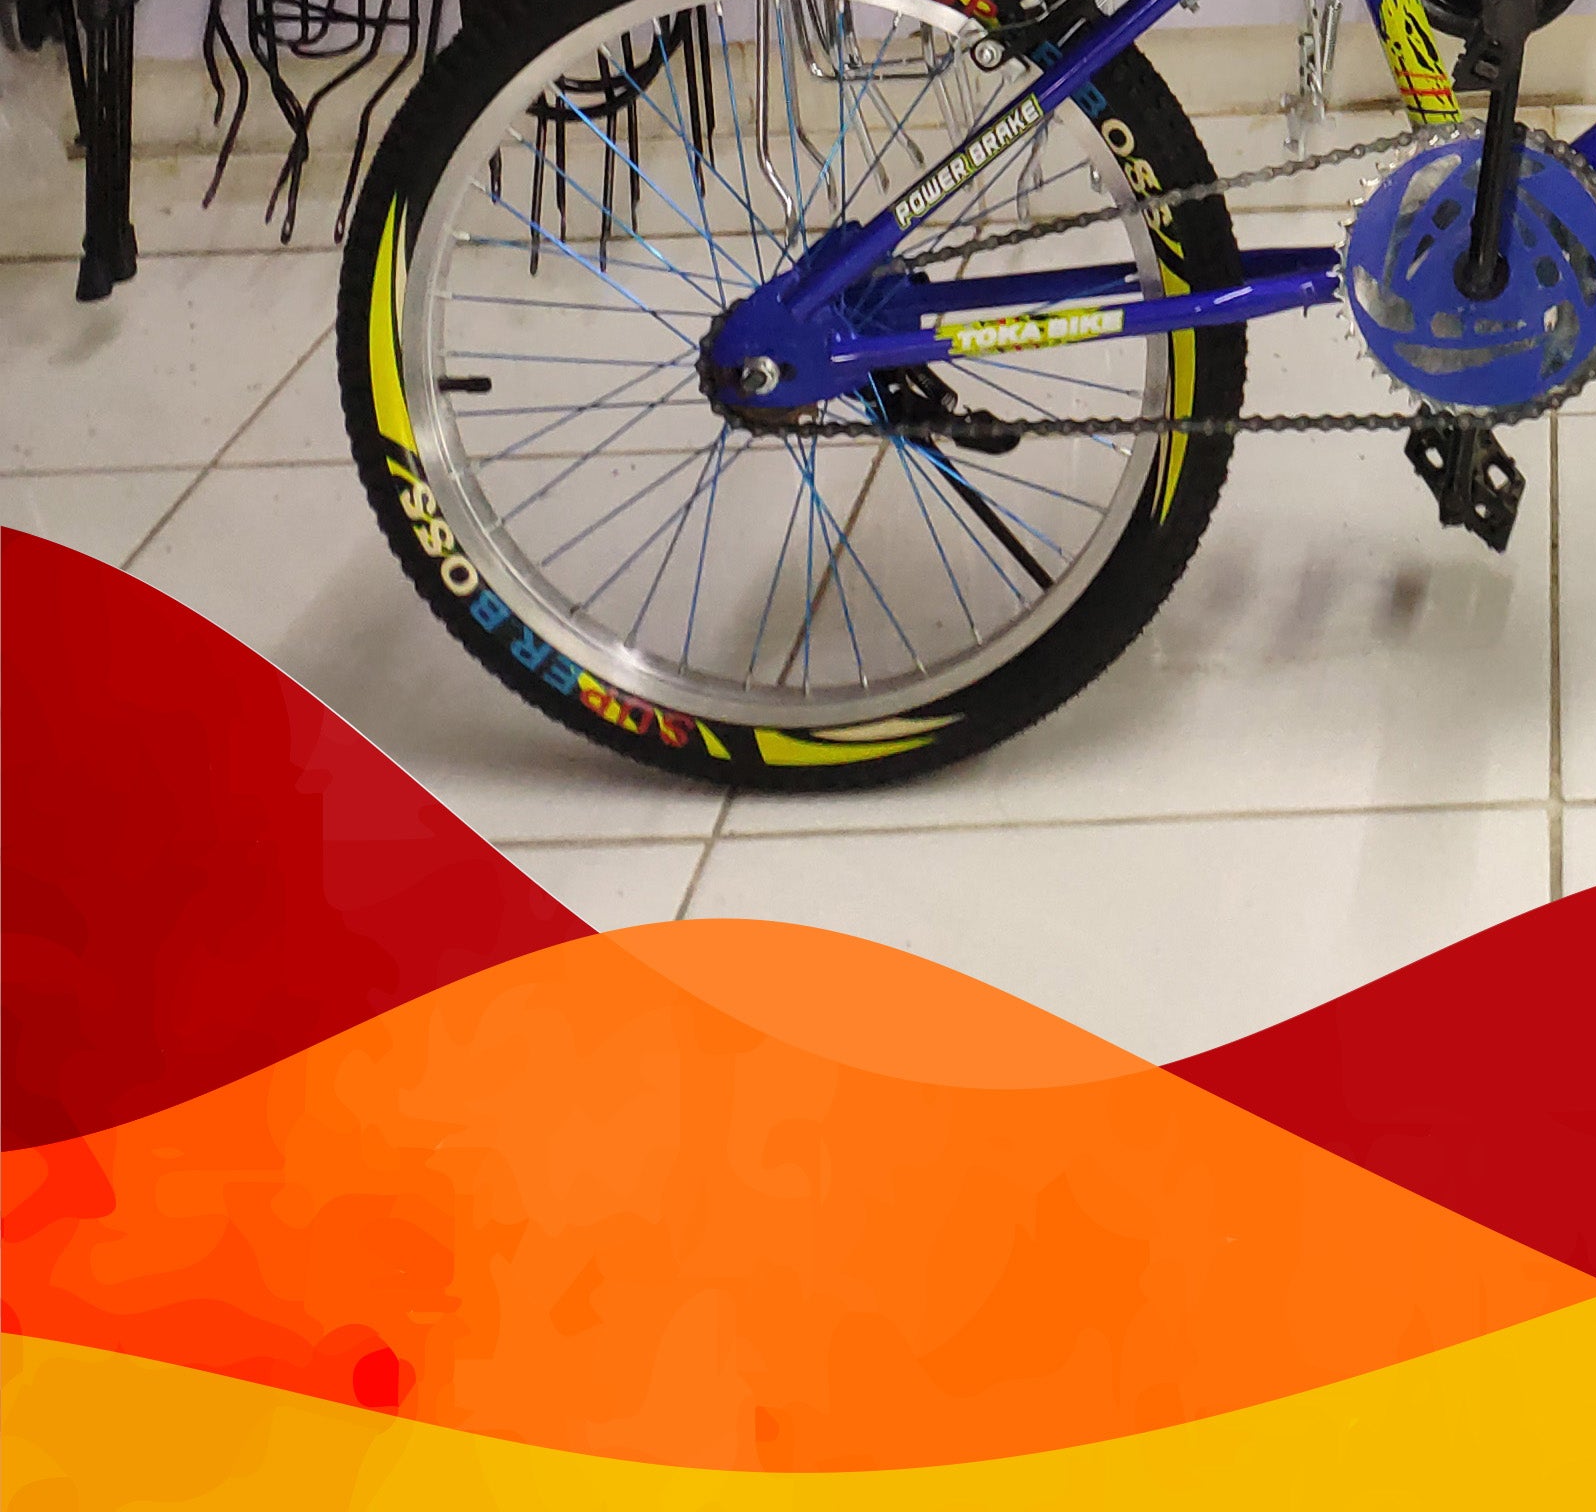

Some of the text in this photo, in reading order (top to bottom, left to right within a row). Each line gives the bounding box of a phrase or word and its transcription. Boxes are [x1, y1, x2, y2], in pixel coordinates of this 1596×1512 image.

[895, 99, 1042, 229] POWER BRAKE
[957, 310, 1124, 350] TOKA BIKE
[401, 482, 696, 749] SUPER BOSS
